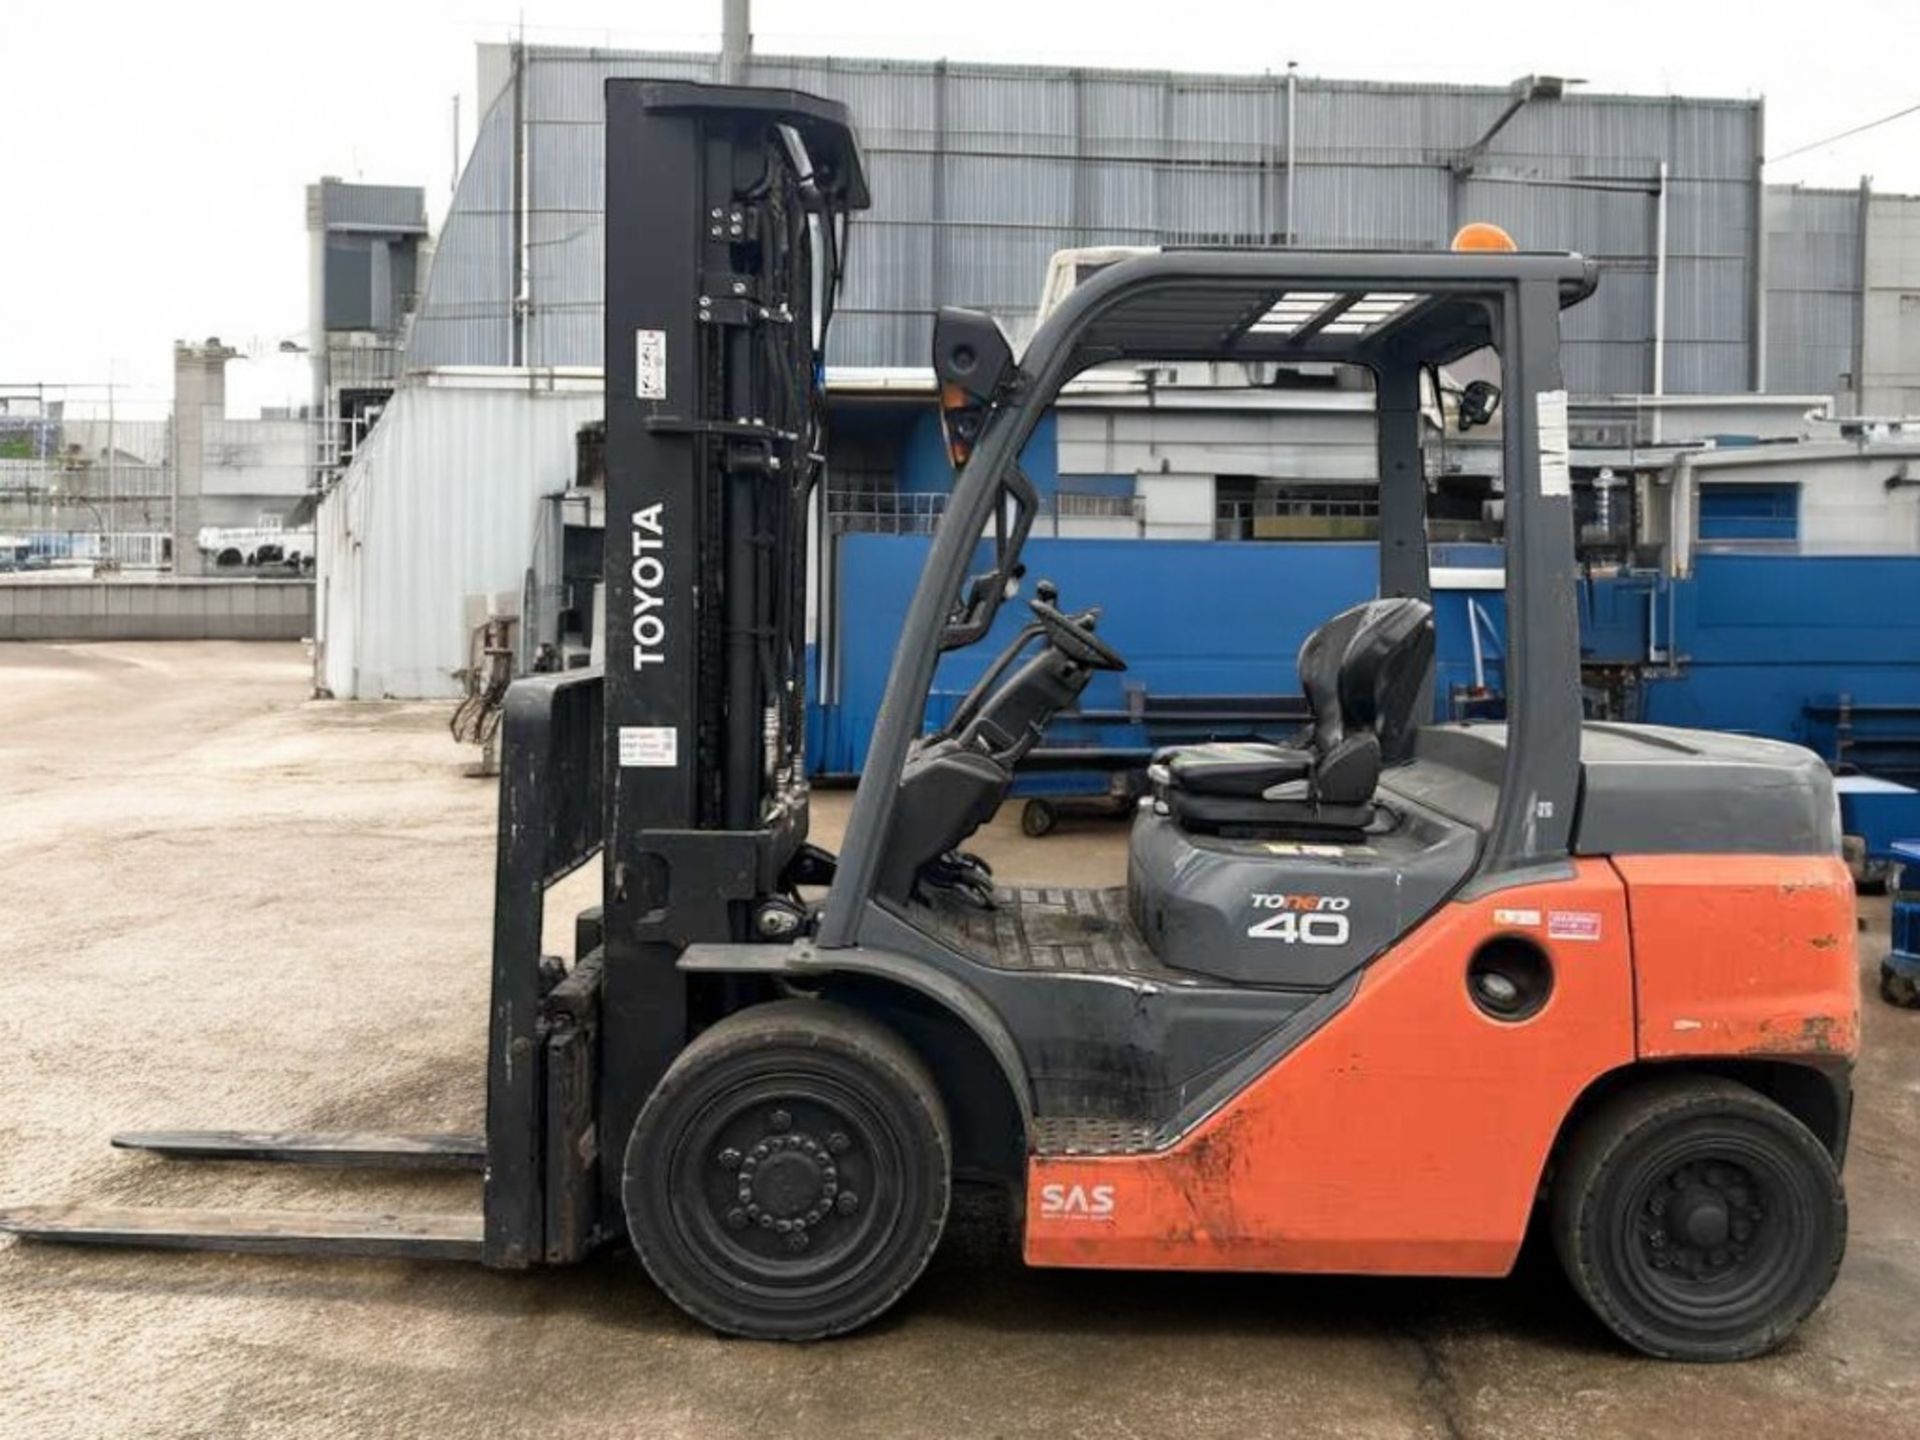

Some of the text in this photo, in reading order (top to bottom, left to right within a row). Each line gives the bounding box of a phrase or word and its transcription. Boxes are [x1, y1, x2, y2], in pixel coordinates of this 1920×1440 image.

[632, 502, 665, 671] TOYOTA
[1248, 912, 1349, 945] 40
[1041, 1184, 1114, 1213] SAS
